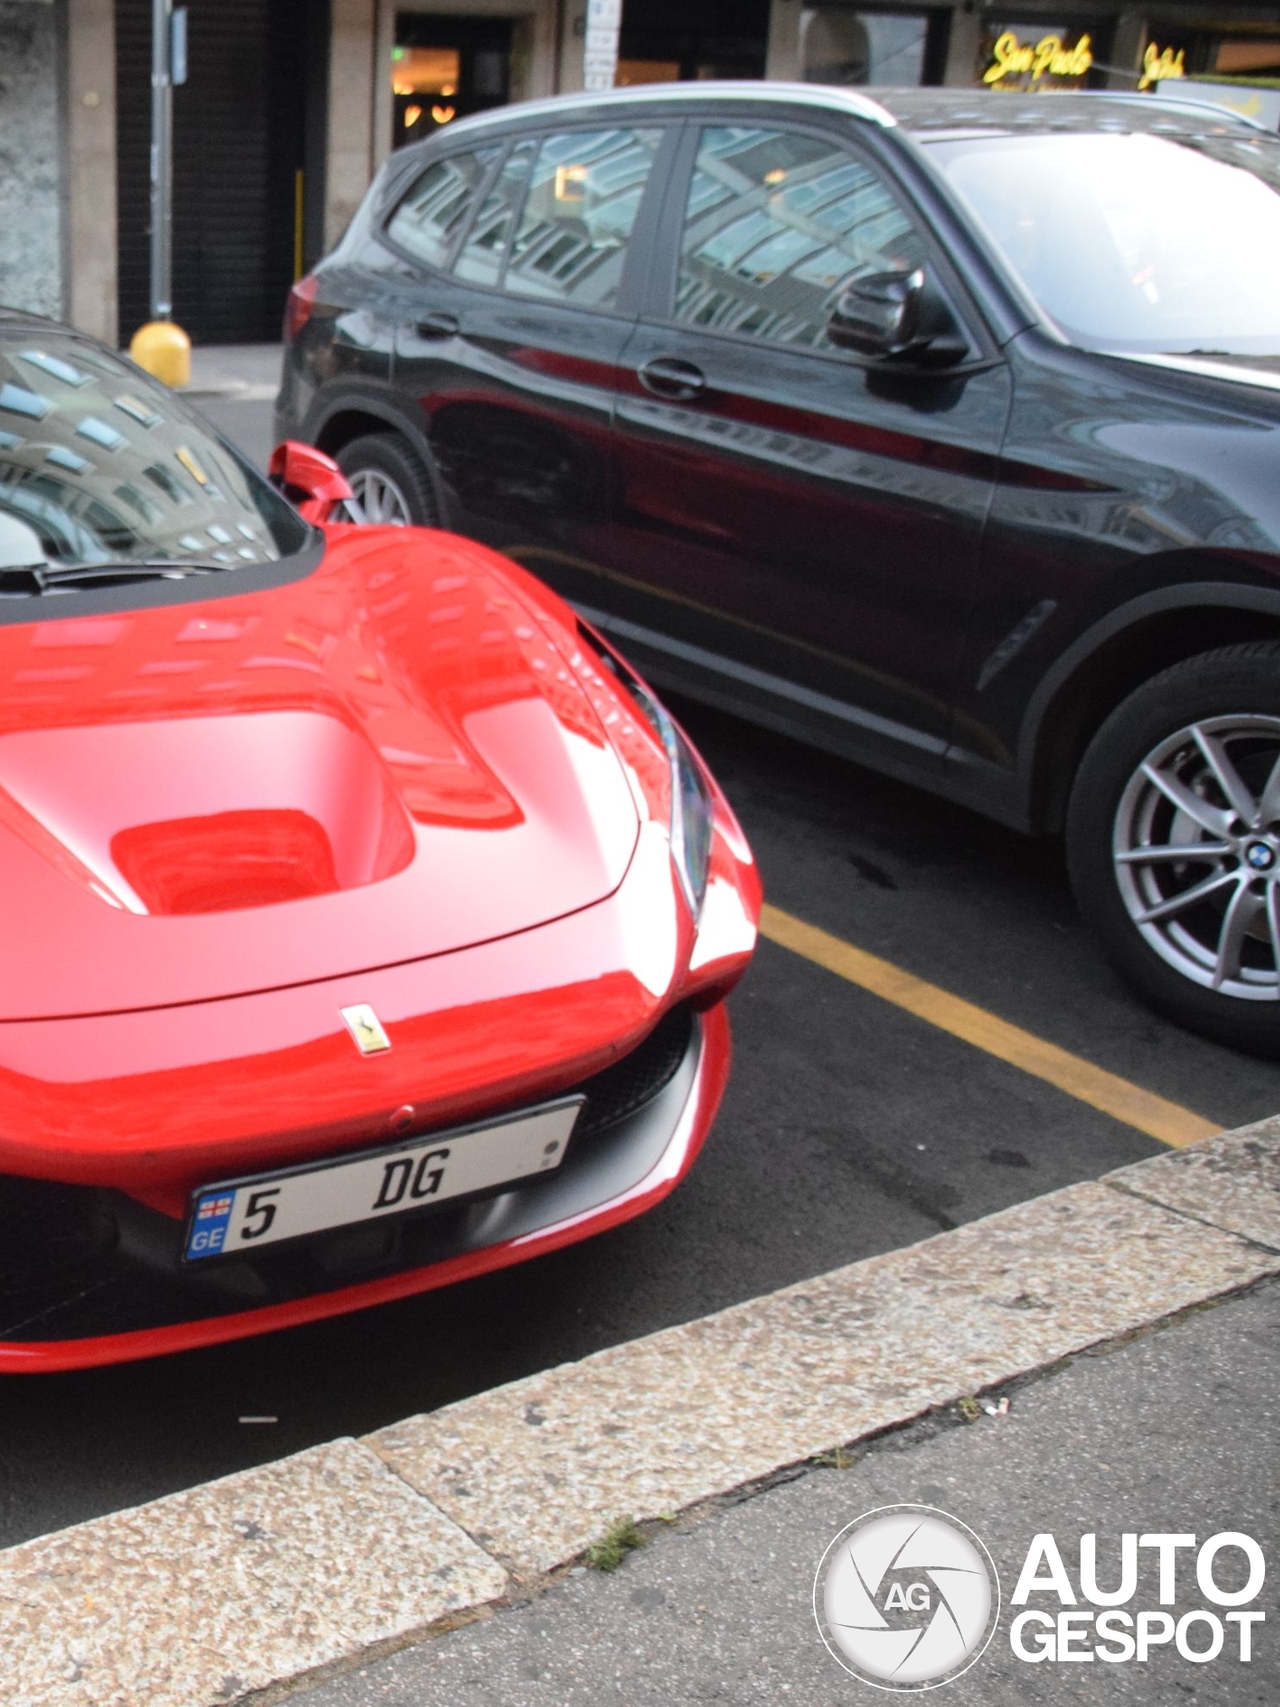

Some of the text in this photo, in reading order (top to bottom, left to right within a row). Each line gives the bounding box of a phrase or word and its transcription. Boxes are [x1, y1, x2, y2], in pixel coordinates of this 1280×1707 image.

[240, 1148, 451, 1240] 5 DG
[190, 1229, 224, 1252] GE
